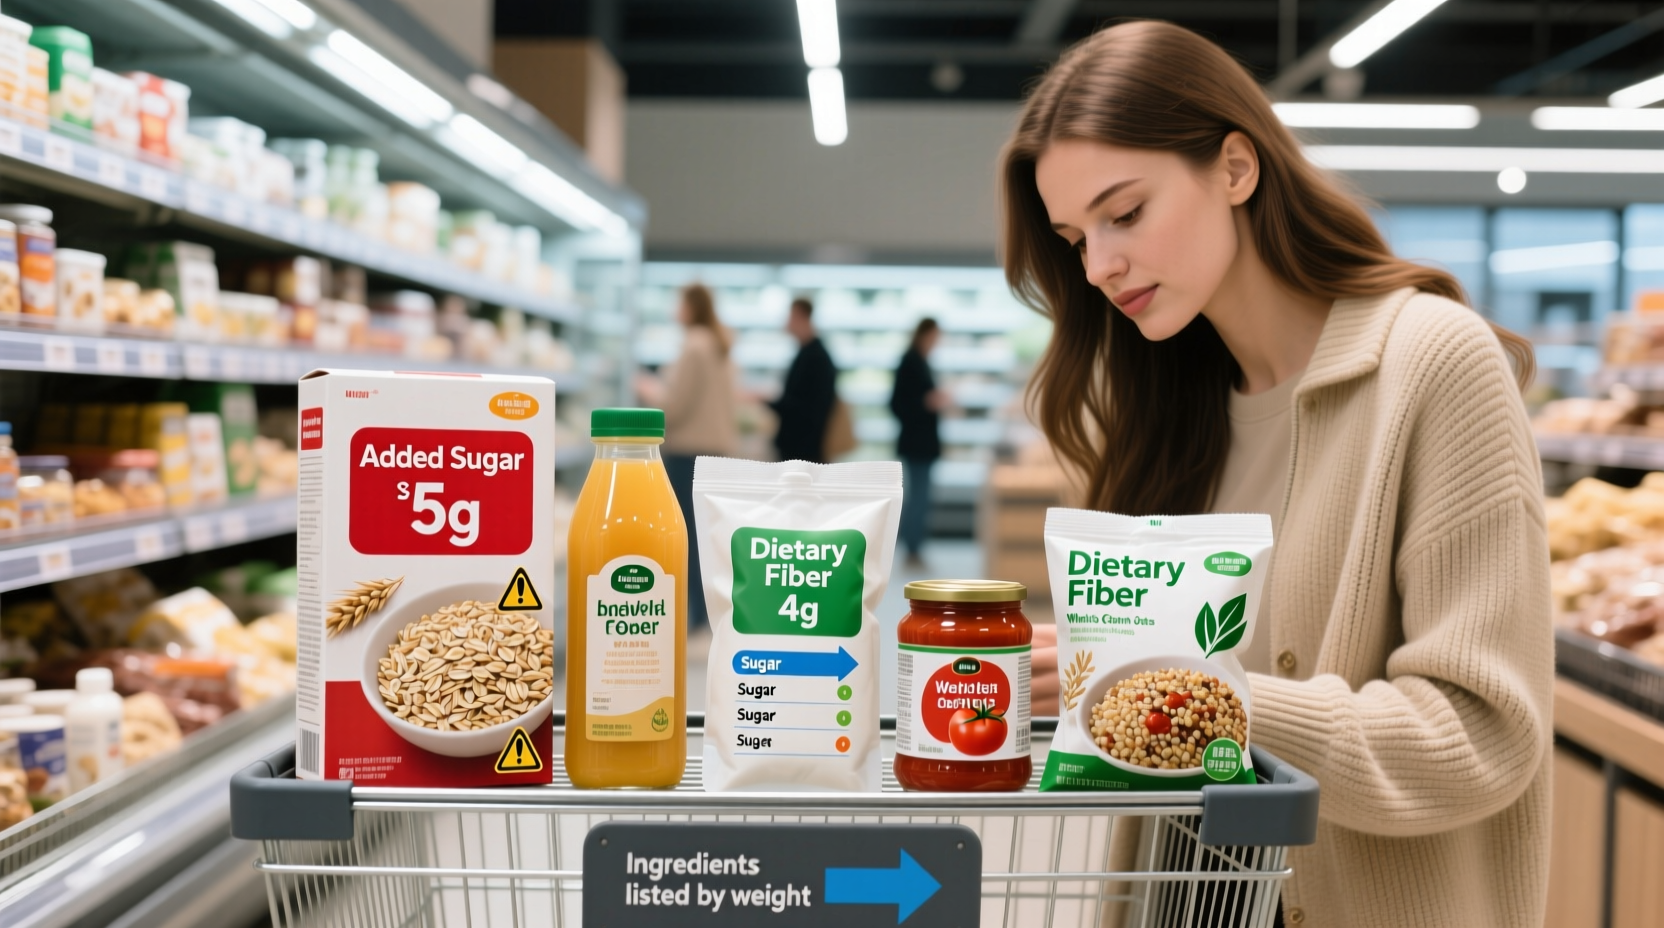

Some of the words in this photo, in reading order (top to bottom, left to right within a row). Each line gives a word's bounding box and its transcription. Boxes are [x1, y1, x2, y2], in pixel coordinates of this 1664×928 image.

[359, 443, 444, 469] Added
[450, 445, 525, 477] Sugar
[750, 537, 847, 567] Dietary
[764, 563, 833, 588] Fiber
[1068, 550, 1186, 586] Dietary
[1068, 579, 1148, 607] Fiber
[777, 594, 819, 629] 4g
[741, 656, 782, 674] Sugar
[737, 682, 777, 699] Sugar
[737, 708, 777, 724] Sugar
[626, 852, 760, 880] Ingredients
[625, 882, 690, 906] listed
[698, 883, 726, 912] by
[731, 884, 811, 912] weight
